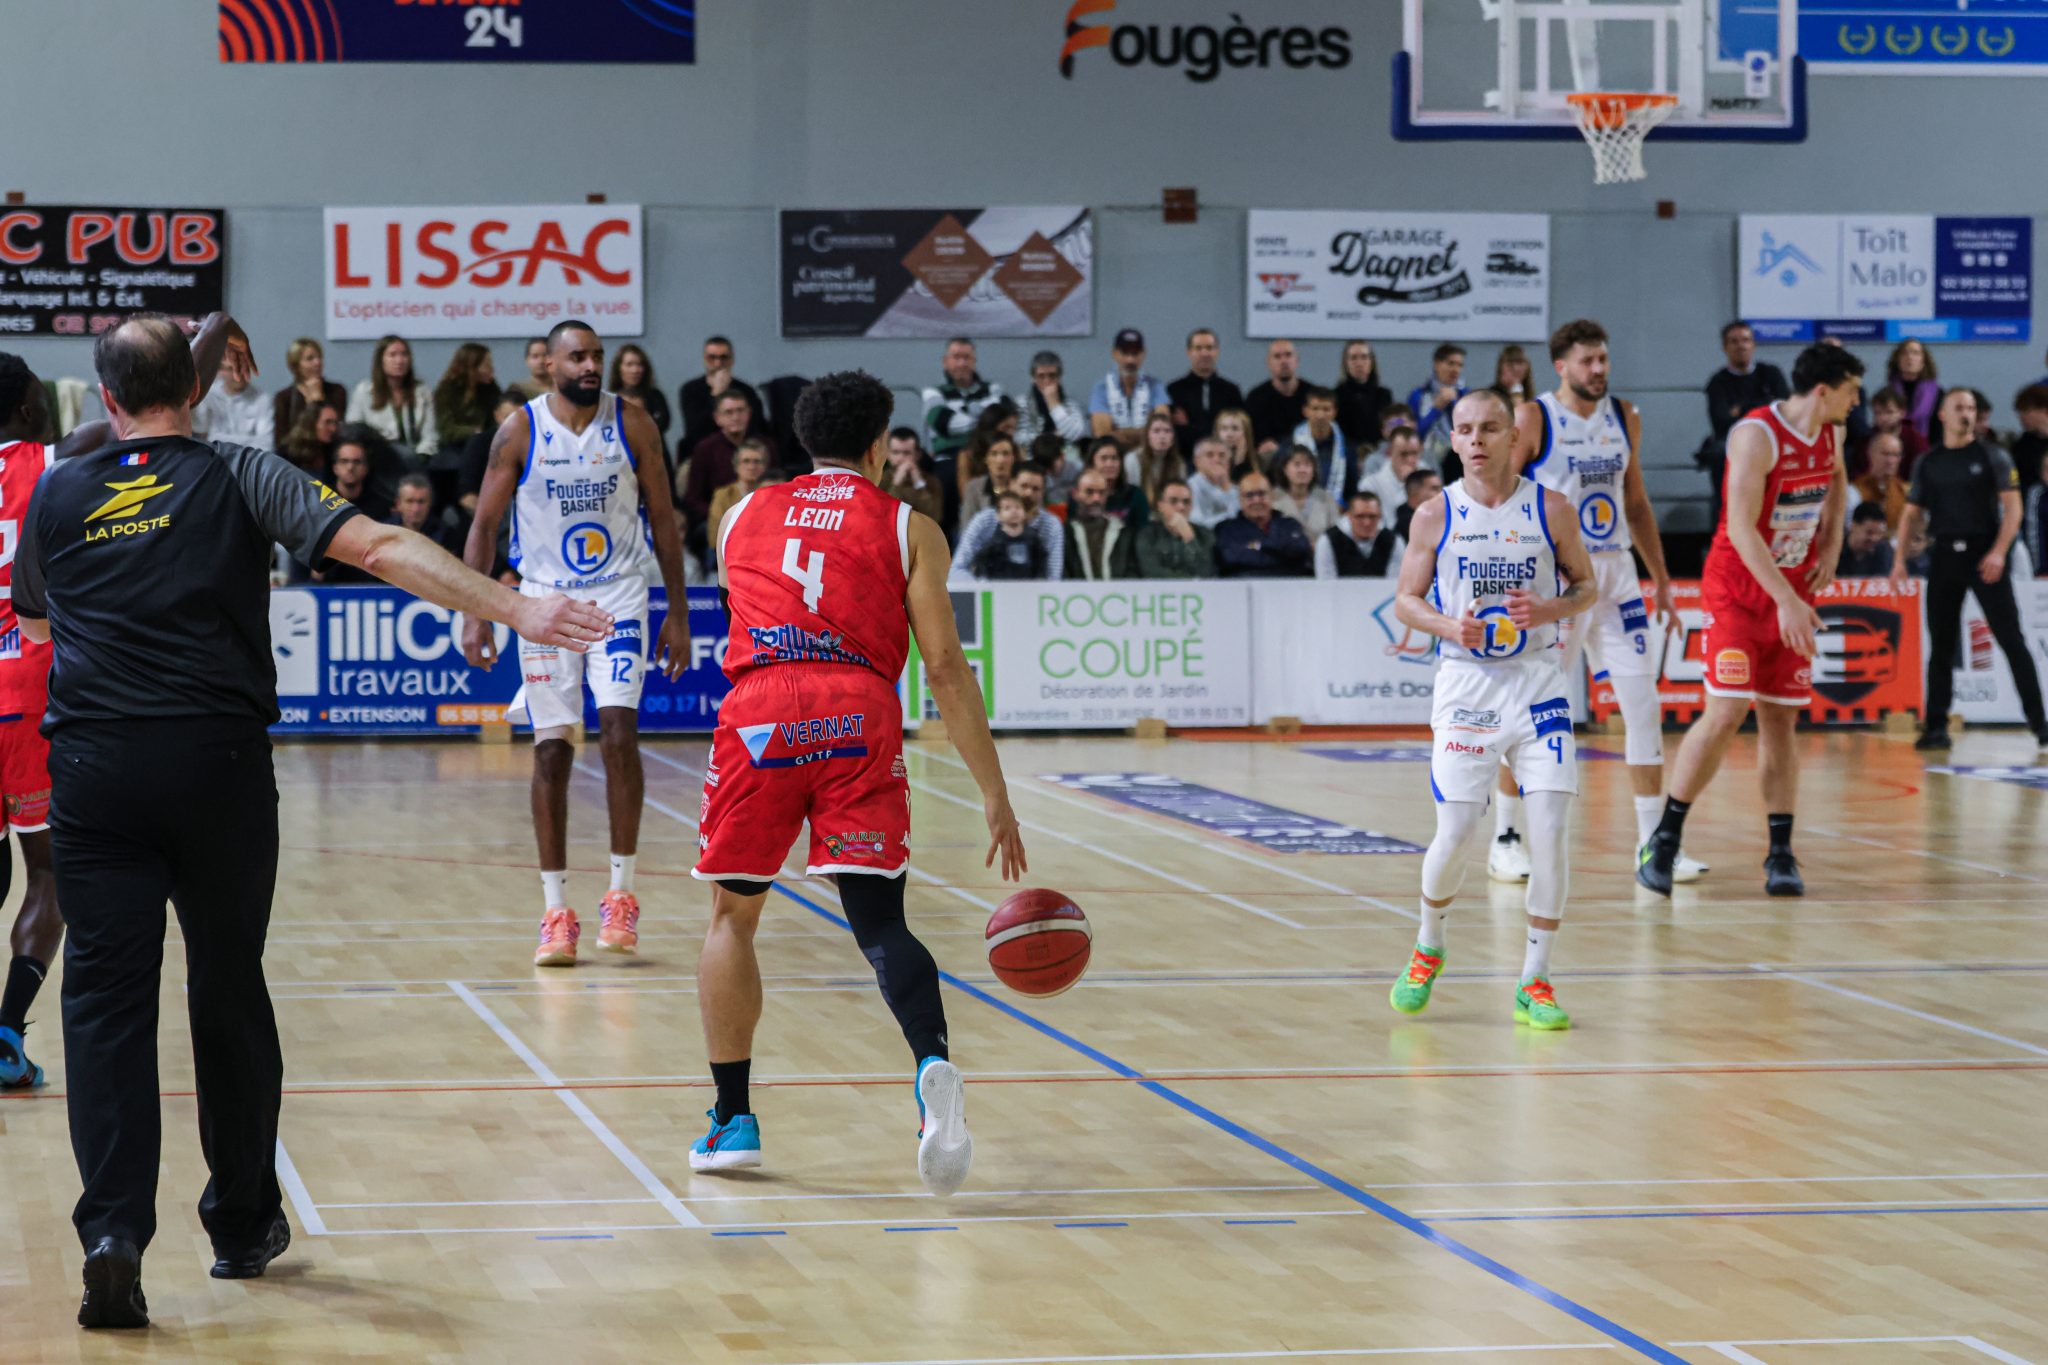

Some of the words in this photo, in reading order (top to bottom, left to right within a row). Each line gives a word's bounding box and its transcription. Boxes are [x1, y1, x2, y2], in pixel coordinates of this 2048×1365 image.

[463, 6, 522, 47] 24
[1059, 0, 1351, 83] Fougères
[67, 213, 219, 266] PUB
[1365, 229, 1445, 246] GARAGE
[1853, 228, 1908, 254] Toit
[334, 219, 631, 289] LISSAC
[1329, 230, 1458, 292] Dagnet
[1850, 261, 1928, 287] Malo
[334, 301, 436, 322] L'opticien
[442, 300, 475, 320] qui
[481, 299, 561, 320] change
[568, 298, 587, 315] la
[601, 425, 615, 442] 12
[792, 491, 854, 502] KNIGHTS
[809, 485, 856, 497] TOURS
[560, 497, 607, 518] BASKET
[783, 505, 845, 531] LEON
[1521, 503, 1532, 521] 4
[85, 527, 109, 541] LA
[111, 514, 171, 538] POSTE
[781, 538, 825, 614] 4
[1038, 593, 1205, 627] ROCHER
[1039, 630, 1204, 678] COUPÉ
[1633, 634, 1646, 655] 9
[328, 663, 472, 696] travaux
[611, 657, 634, 684] 12
[1041, 683, 1128, 700] Décoration
[1133, 684, 1153, 699] de
[1160, 684, 1209, 699] Jardin
[328, 708, 427, 724] EXTENSION
[780, 713, 865, 747] VERNAT
[1445, 741, 1486, 755] Abera
[1547, 736, 1563, 765] 4
